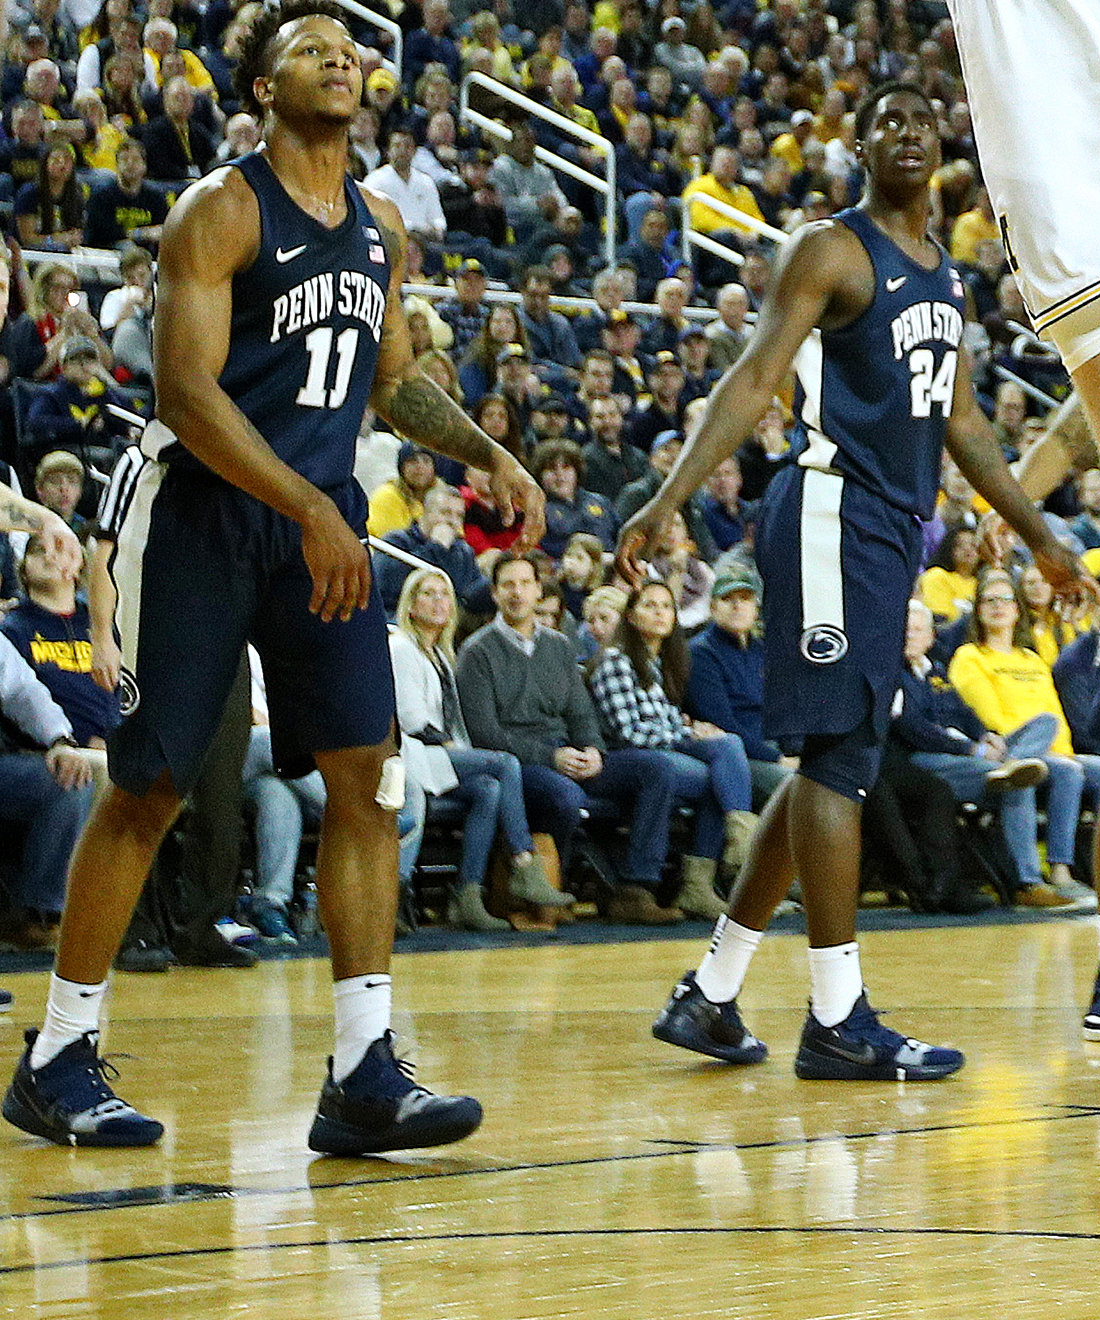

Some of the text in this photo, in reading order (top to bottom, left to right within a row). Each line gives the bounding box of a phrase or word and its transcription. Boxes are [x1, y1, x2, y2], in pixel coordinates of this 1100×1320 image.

[270, 272, 334, 343] PENN
[891, 301, 932, 360] PENN
[296, 327, 359, 409] 11
[909, 349, 957, 418] 24
